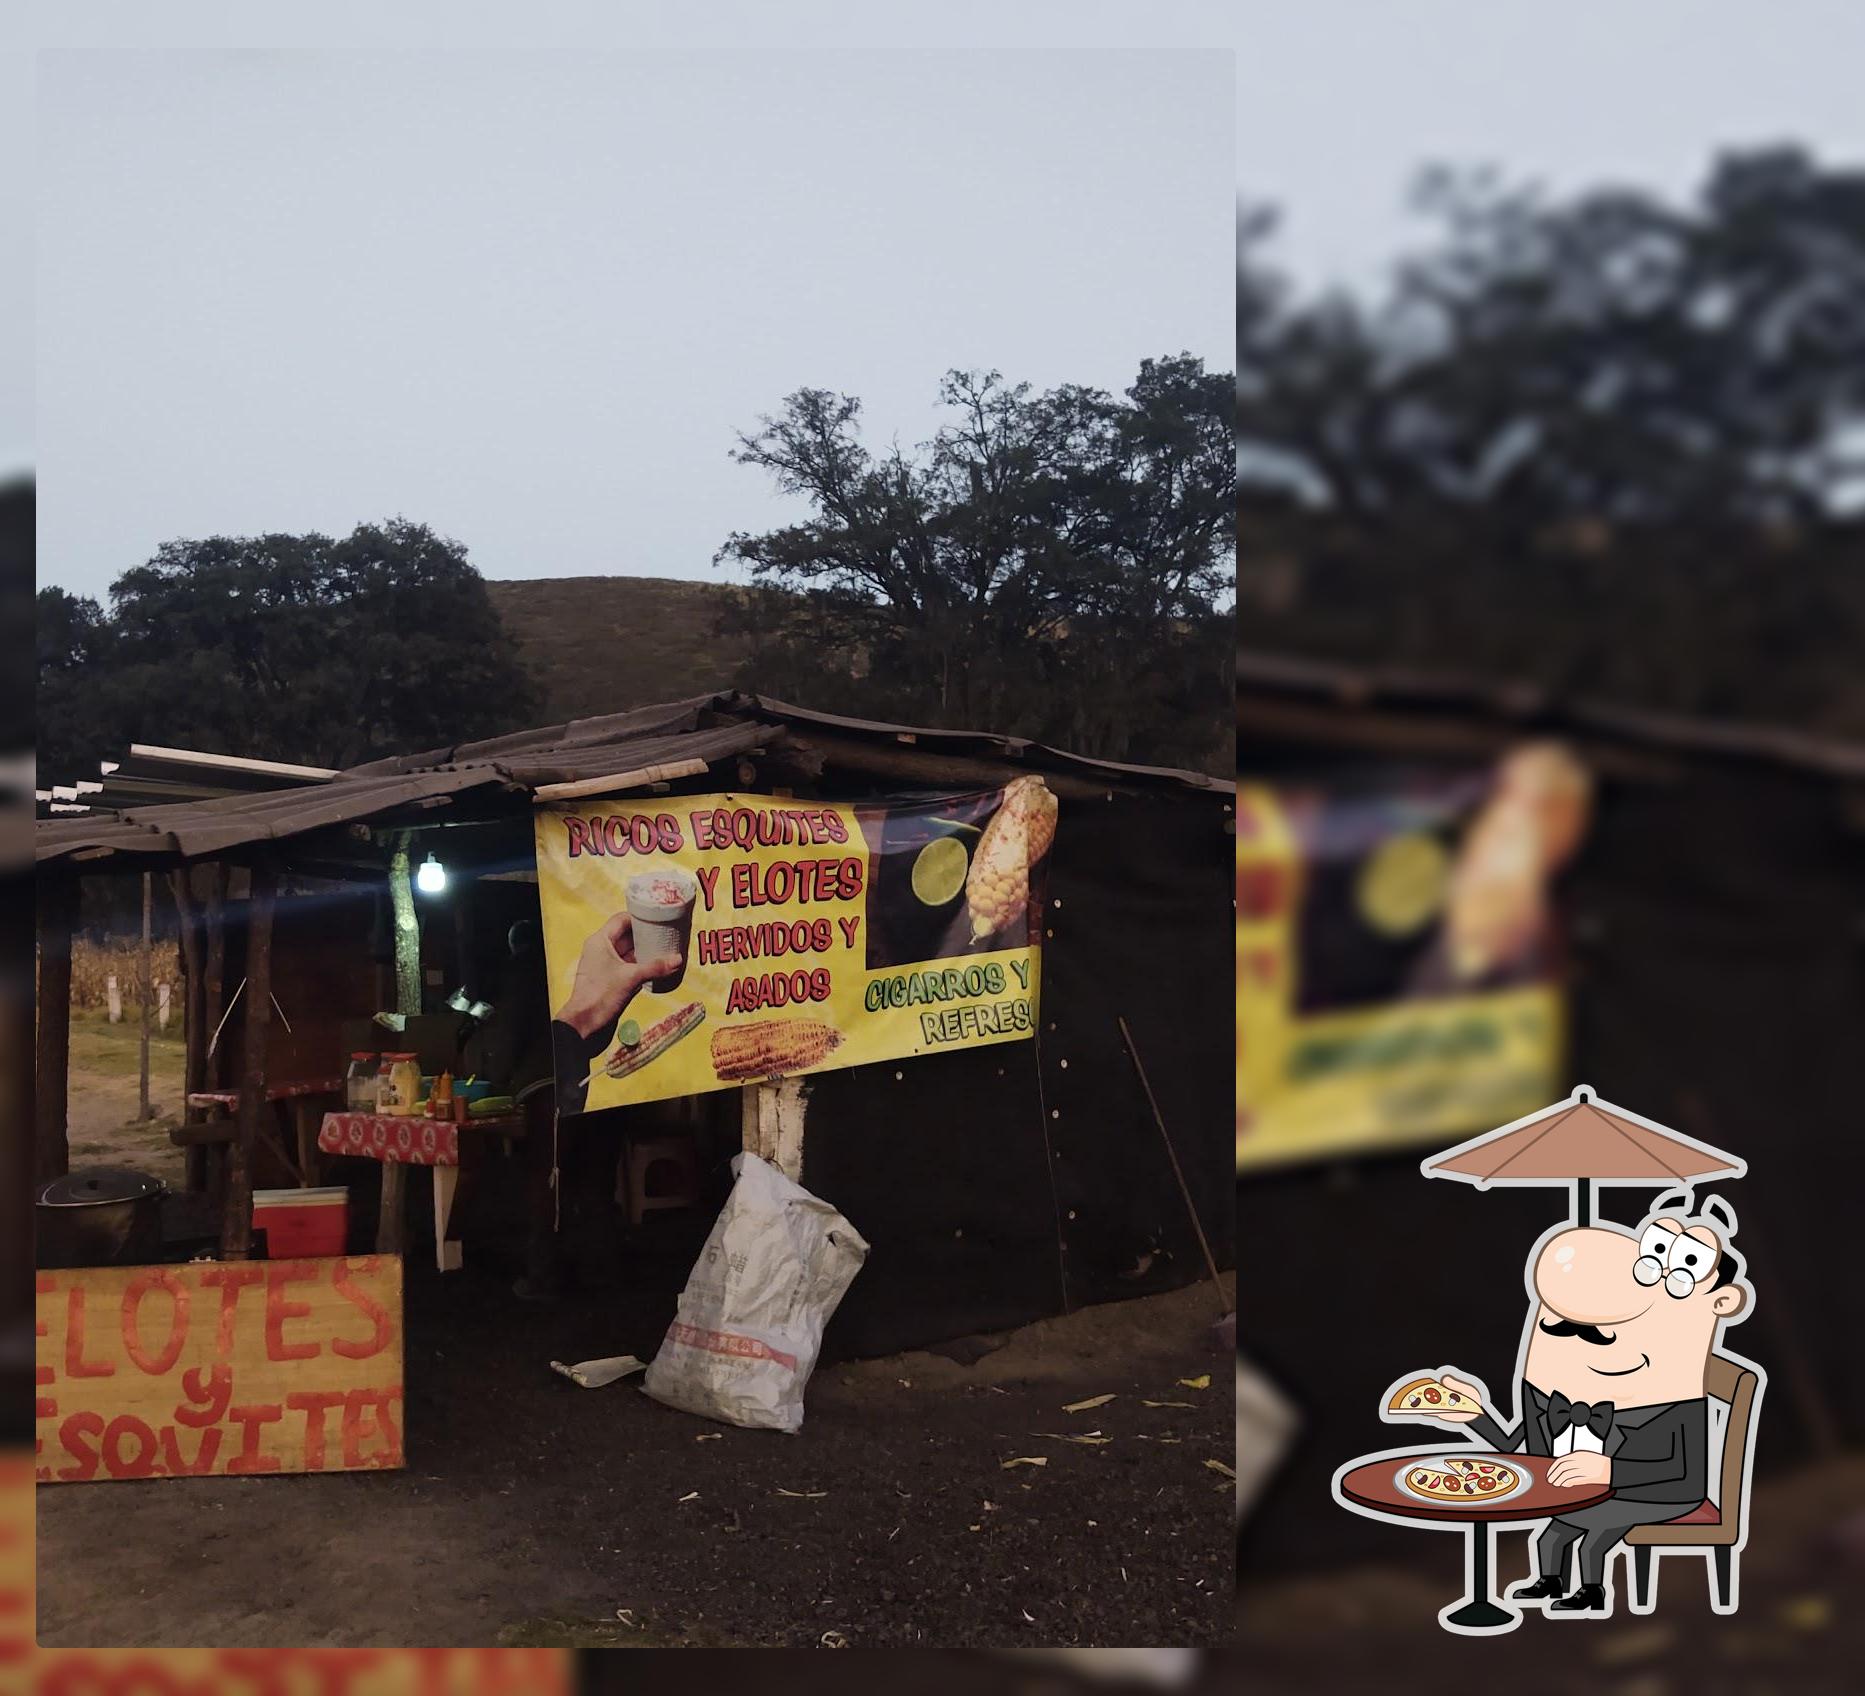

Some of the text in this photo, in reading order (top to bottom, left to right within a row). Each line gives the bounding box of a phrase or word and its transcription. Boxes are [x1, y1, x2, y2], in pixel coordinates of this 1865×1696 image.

[563, 808, 849, 857] RICOS ESQUITES
[696, 857, 863, 911] Y ELOTES
[698, 916, 860, 965] HERVIDOS Y
[725, 968, 831, 1014] ASADOS
[865, 958, 1030, 1012] CIGARROS Y
[920, 996, 1035, 1044] REFRES
